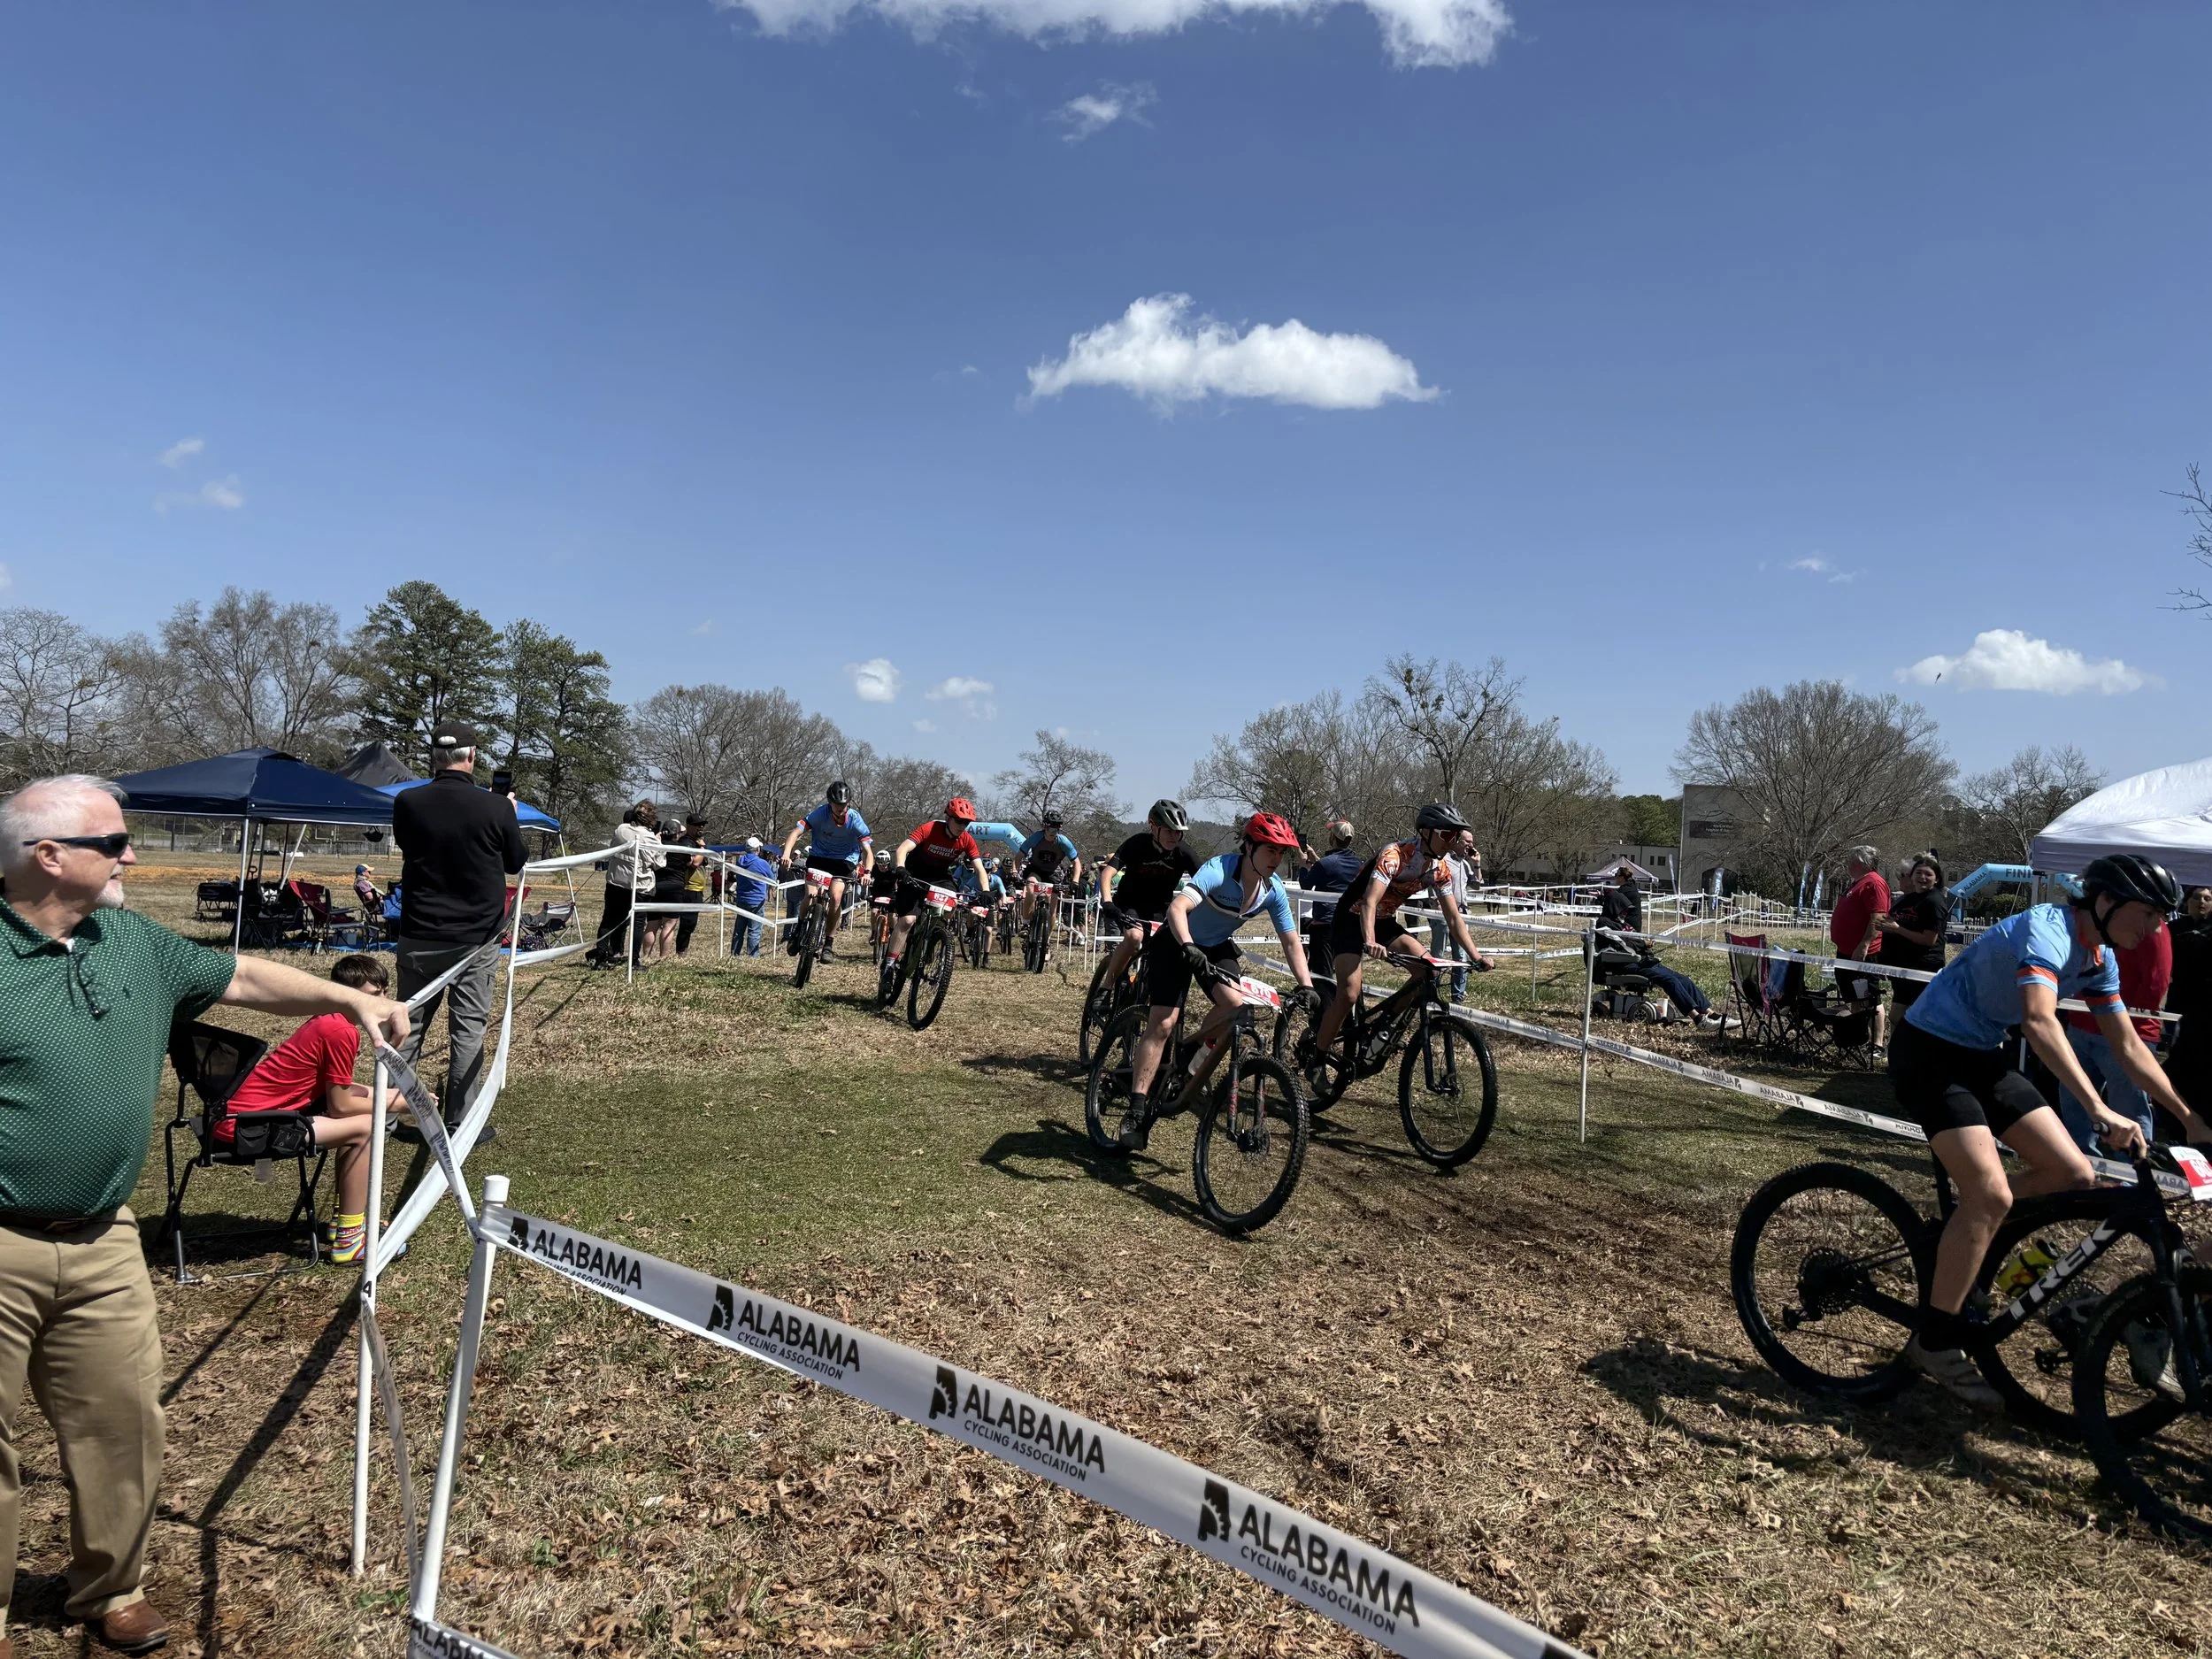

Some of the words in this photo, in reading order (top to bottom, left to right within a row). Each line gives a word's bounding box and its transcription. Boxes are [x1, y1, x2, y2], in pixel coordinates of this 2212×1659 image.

[967, 825, 991, 835] ART
[2005, 867, 2032, 879] FINI
[1250, 984, 1271, 999] 670
[2189, 1158, 2212, 1179] 60
[532, 1229, 642, 1290] ALABAMA
[2009, 1218, 2116, 1320] TREK
[737, 1331, 778, 1355] CYCLING
[779, 1348, 843, 1380] ASSOCIATION
[738, 1299, 860, 1371] ALABAMA
[963, 1383, 1105, 1474] ALABAMA
[964, 1419, 1010, 1448] CYCLING
[1011, 1440, 1087, 1482] ASSOCIATION
[1238, 1503, 1420, 1628] ALABAMA
[1240, 1545, 1298, 1585] CYCLING
[1300, 1576, 1397, 1636] ASSOCIATION
